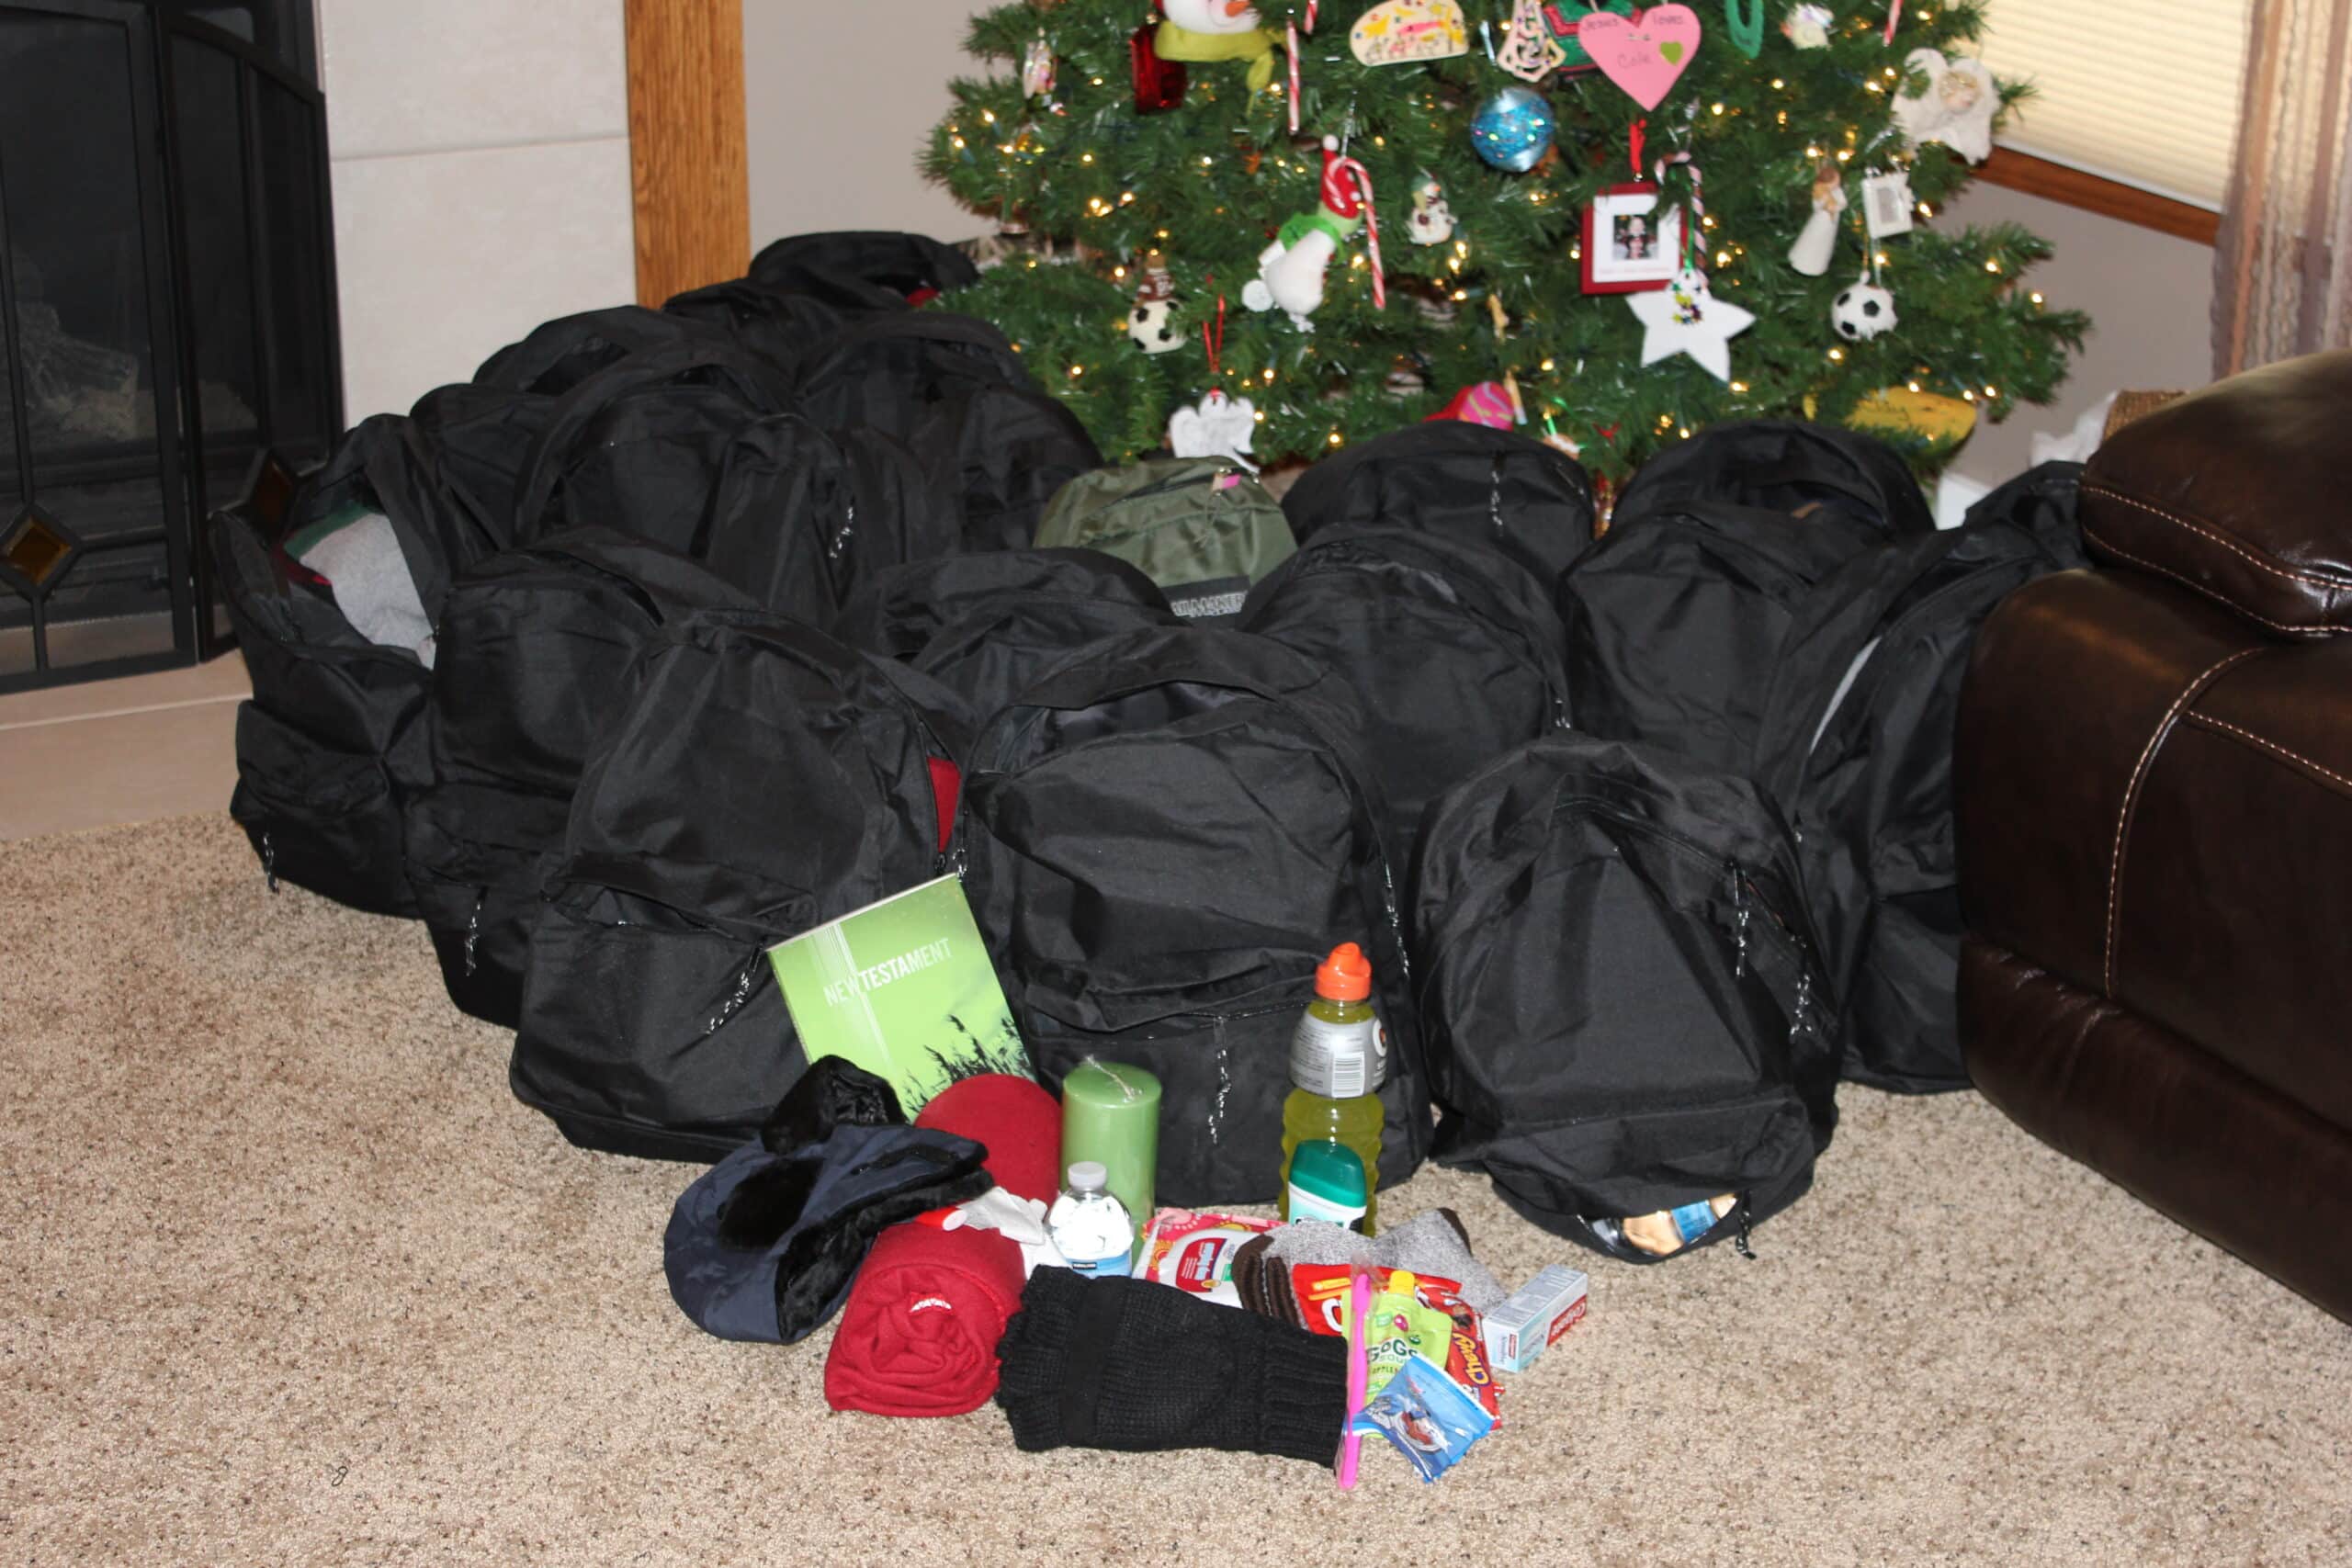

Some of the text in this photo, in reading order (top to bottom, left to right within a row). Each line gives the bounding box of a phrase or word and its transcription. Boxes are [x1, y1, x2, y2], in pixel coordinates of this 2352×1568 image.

[823, 938, 952, 1007] NEW TESTAMENT
[1453, 1332, 1490, 1384] Chewy
